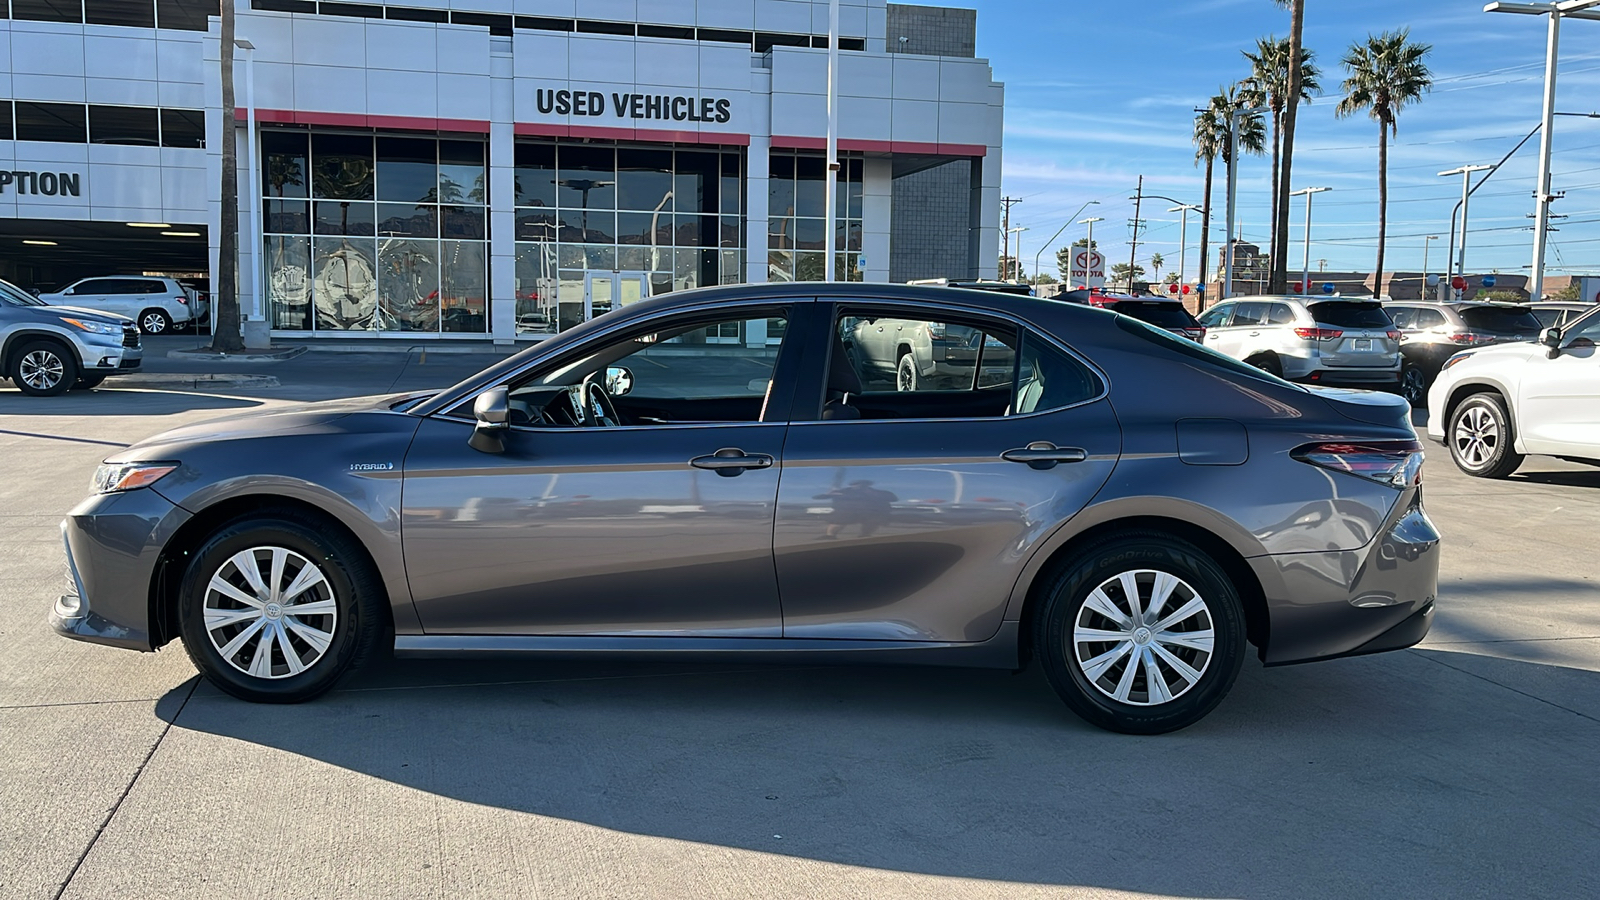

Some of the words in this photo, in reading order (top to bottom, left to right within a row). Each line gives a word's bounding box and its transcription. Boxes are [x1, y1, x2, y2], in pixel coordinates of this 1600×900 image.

[537, 88, 605, 116] USED
[612, 93, 731, 124] VEHICLES
[350, 463, 387, 471] HYBRID
[1099, 549, 1164, 568] GeoDrive
